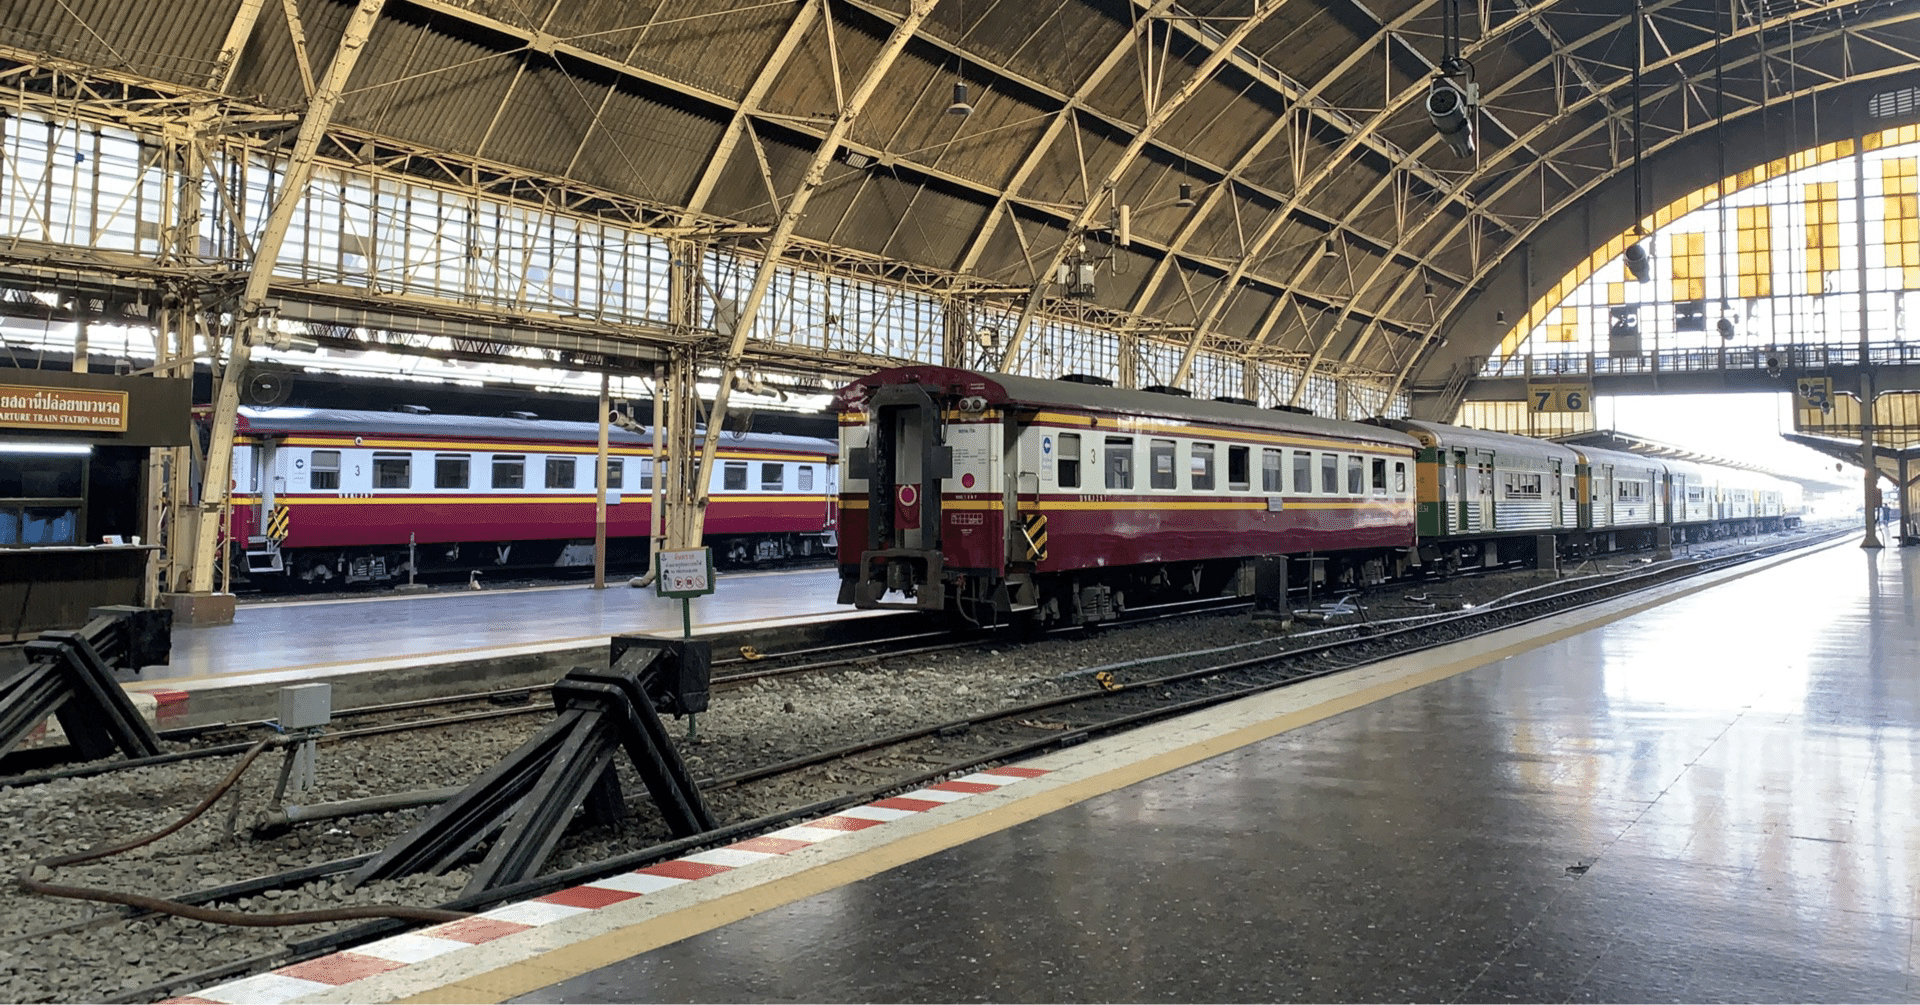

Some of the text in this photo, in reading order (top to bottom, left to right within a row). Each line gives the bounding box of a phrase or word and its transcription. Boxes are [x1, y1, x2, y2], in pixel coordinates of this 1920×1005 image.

[1535, 392, 1551, 411] 7
[1566, 392, 1582, 410] 6
[33, 413, 58, 423] TRAIN
[60, 414, 90, 424] STATION
[91, 416, 120, 426] MASTER
[1091, 448, 1096, 465] 3
[354, 464, 361, 477] 3
